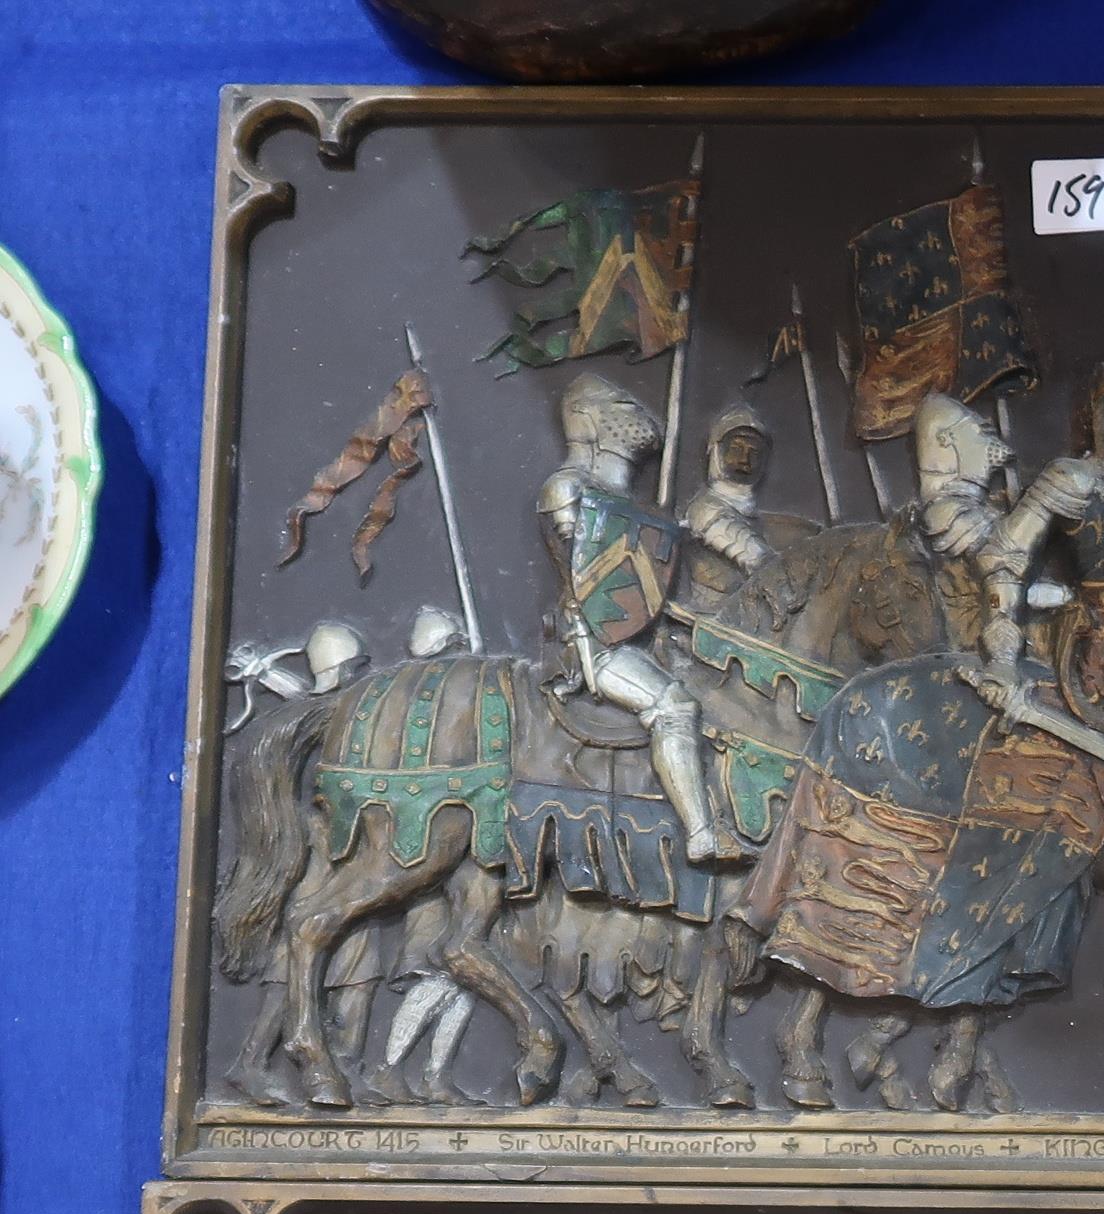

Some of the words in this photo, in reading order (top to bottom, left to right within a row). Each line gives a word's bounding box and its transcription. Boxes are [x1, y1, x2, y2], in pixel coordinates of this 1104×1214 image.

[375, 1130, 419, 1153] 1415
[498, 1132, 530, 1152] Sir
[537, 1133, 614, 1153] Walter
[824, 1136, 878, 1155] Lord
